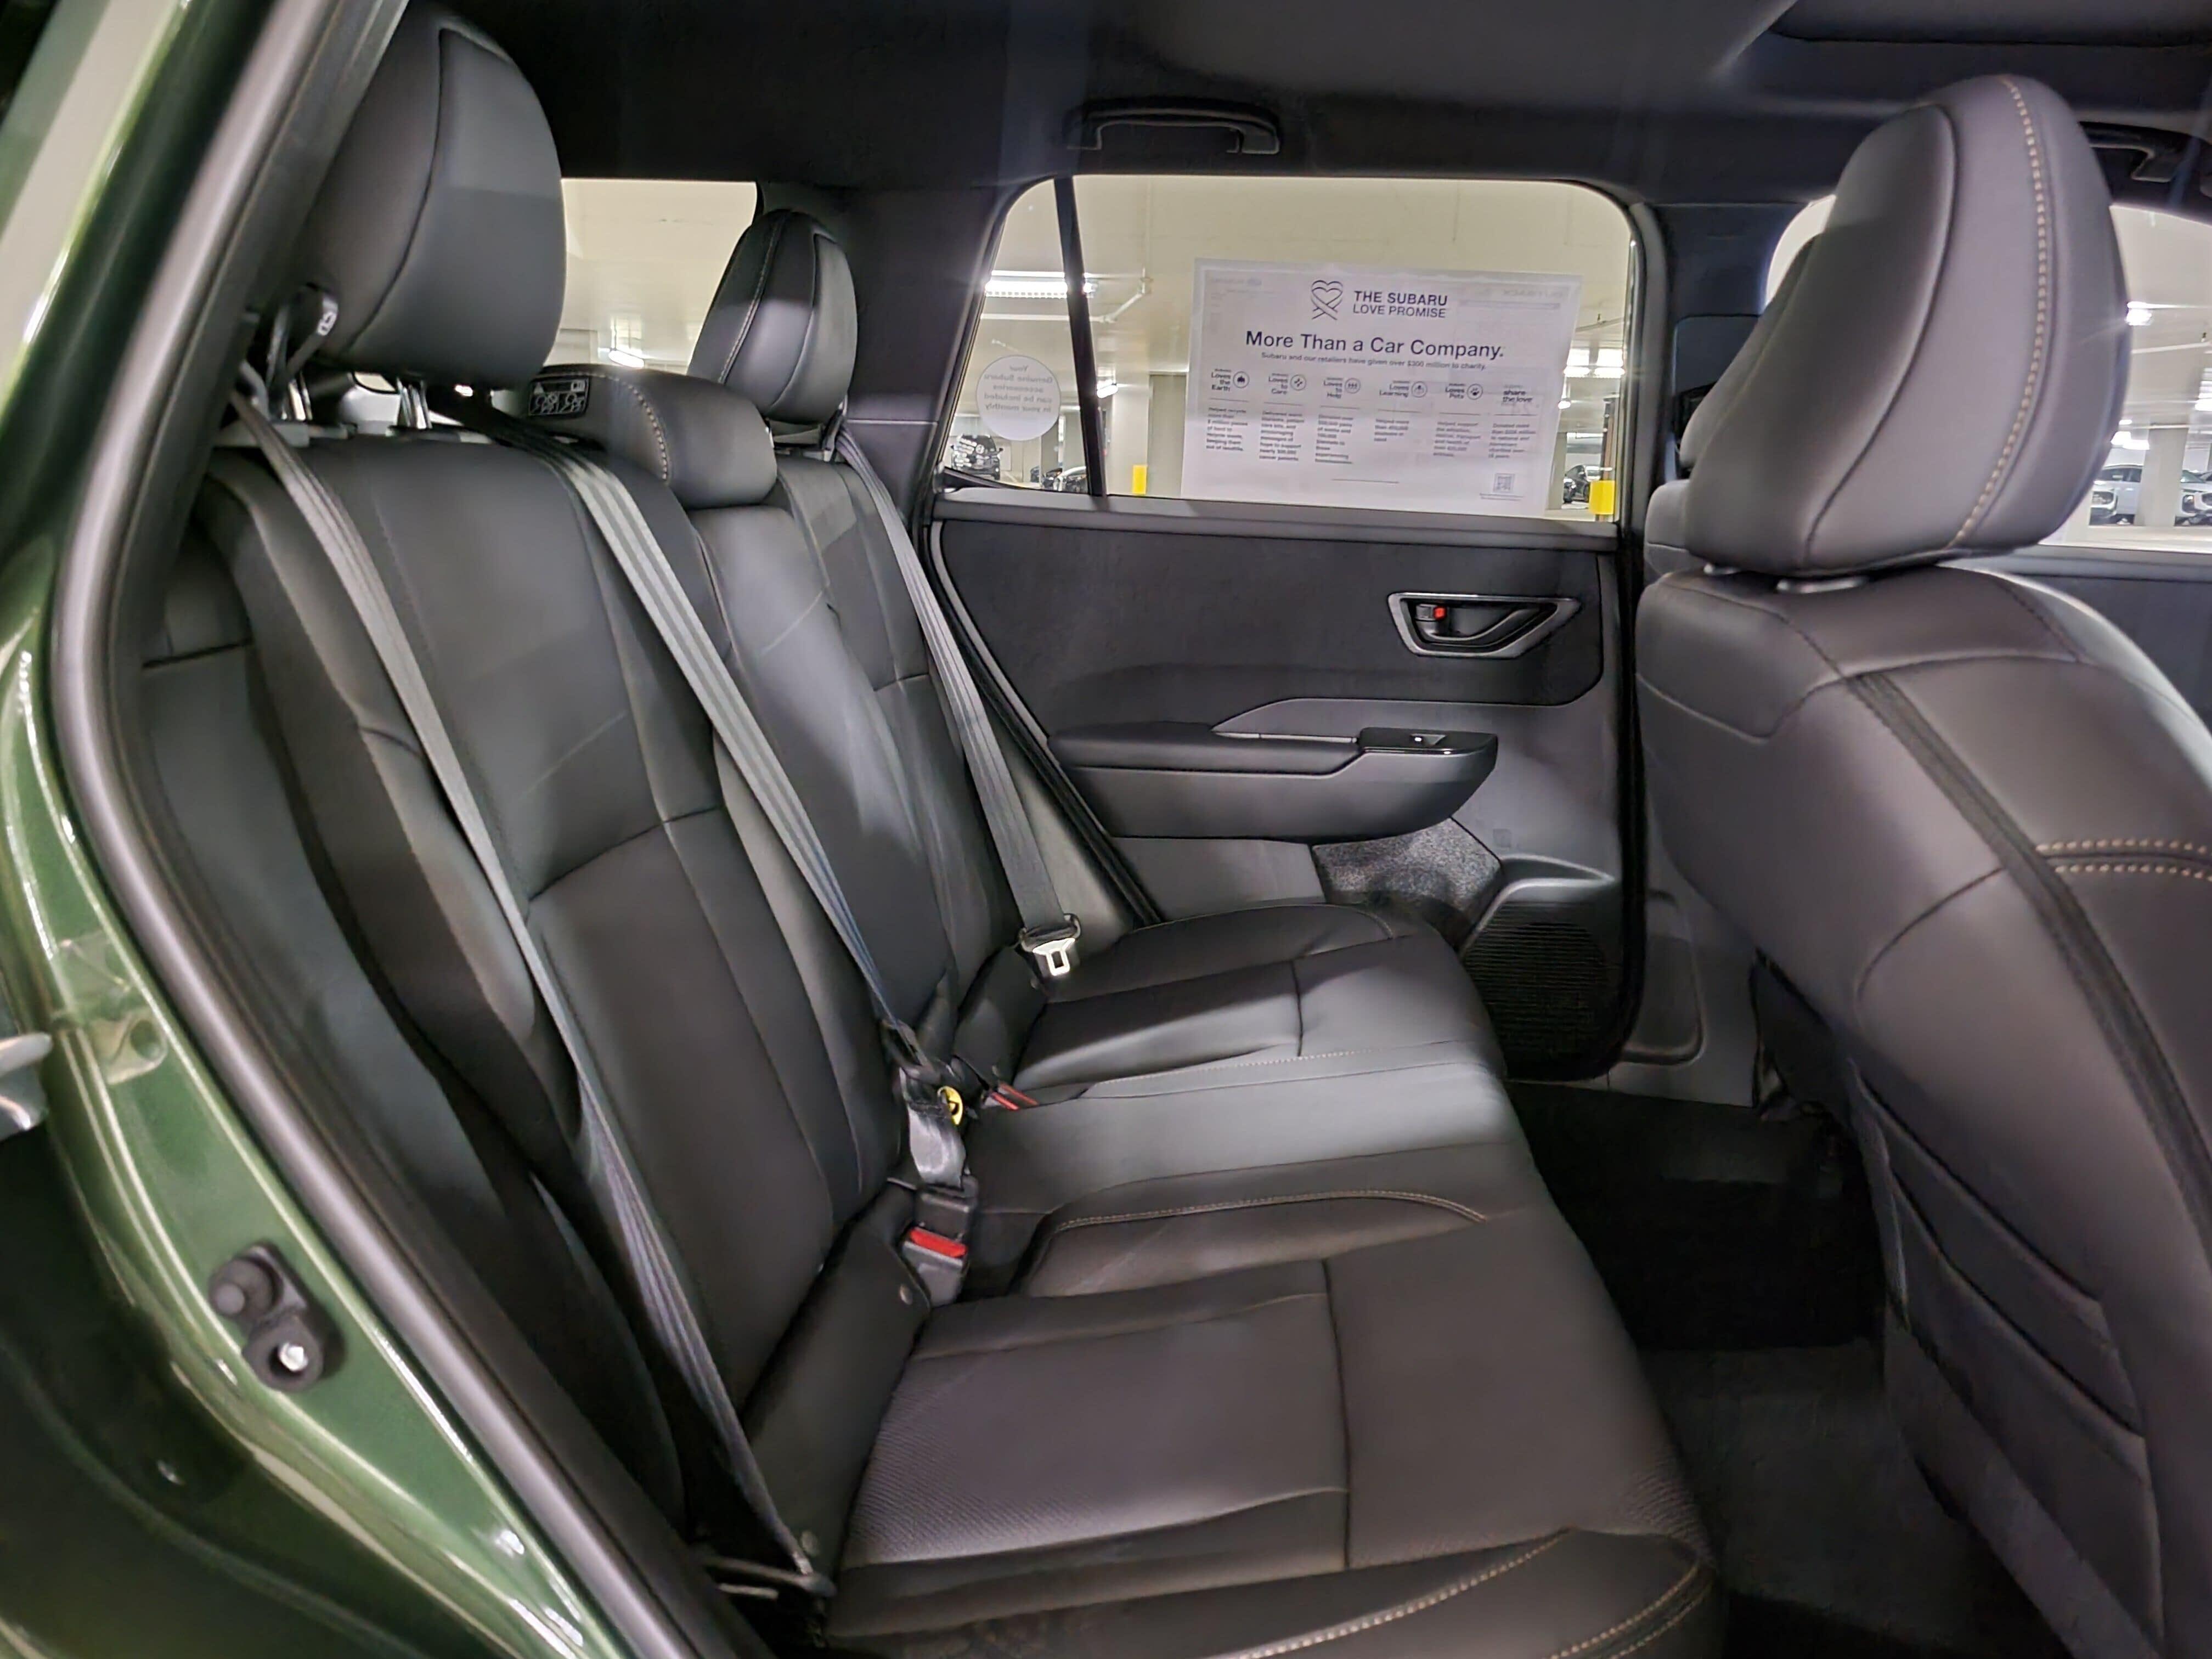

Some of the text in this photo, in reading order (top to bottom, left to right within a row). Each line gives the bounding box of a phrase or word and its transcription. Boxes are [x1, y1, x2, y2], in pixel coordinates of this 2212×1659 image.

[1354, 291, 1448, 306] THE SUBARU
[1353, 304, 1447, 318] LOVE PROMISE
[1246, 331, 1503, 360] More Than a Car Company.
[1261, 352, 1287, 360] Subaru
[1211, 371, 1231, 380] Loves
